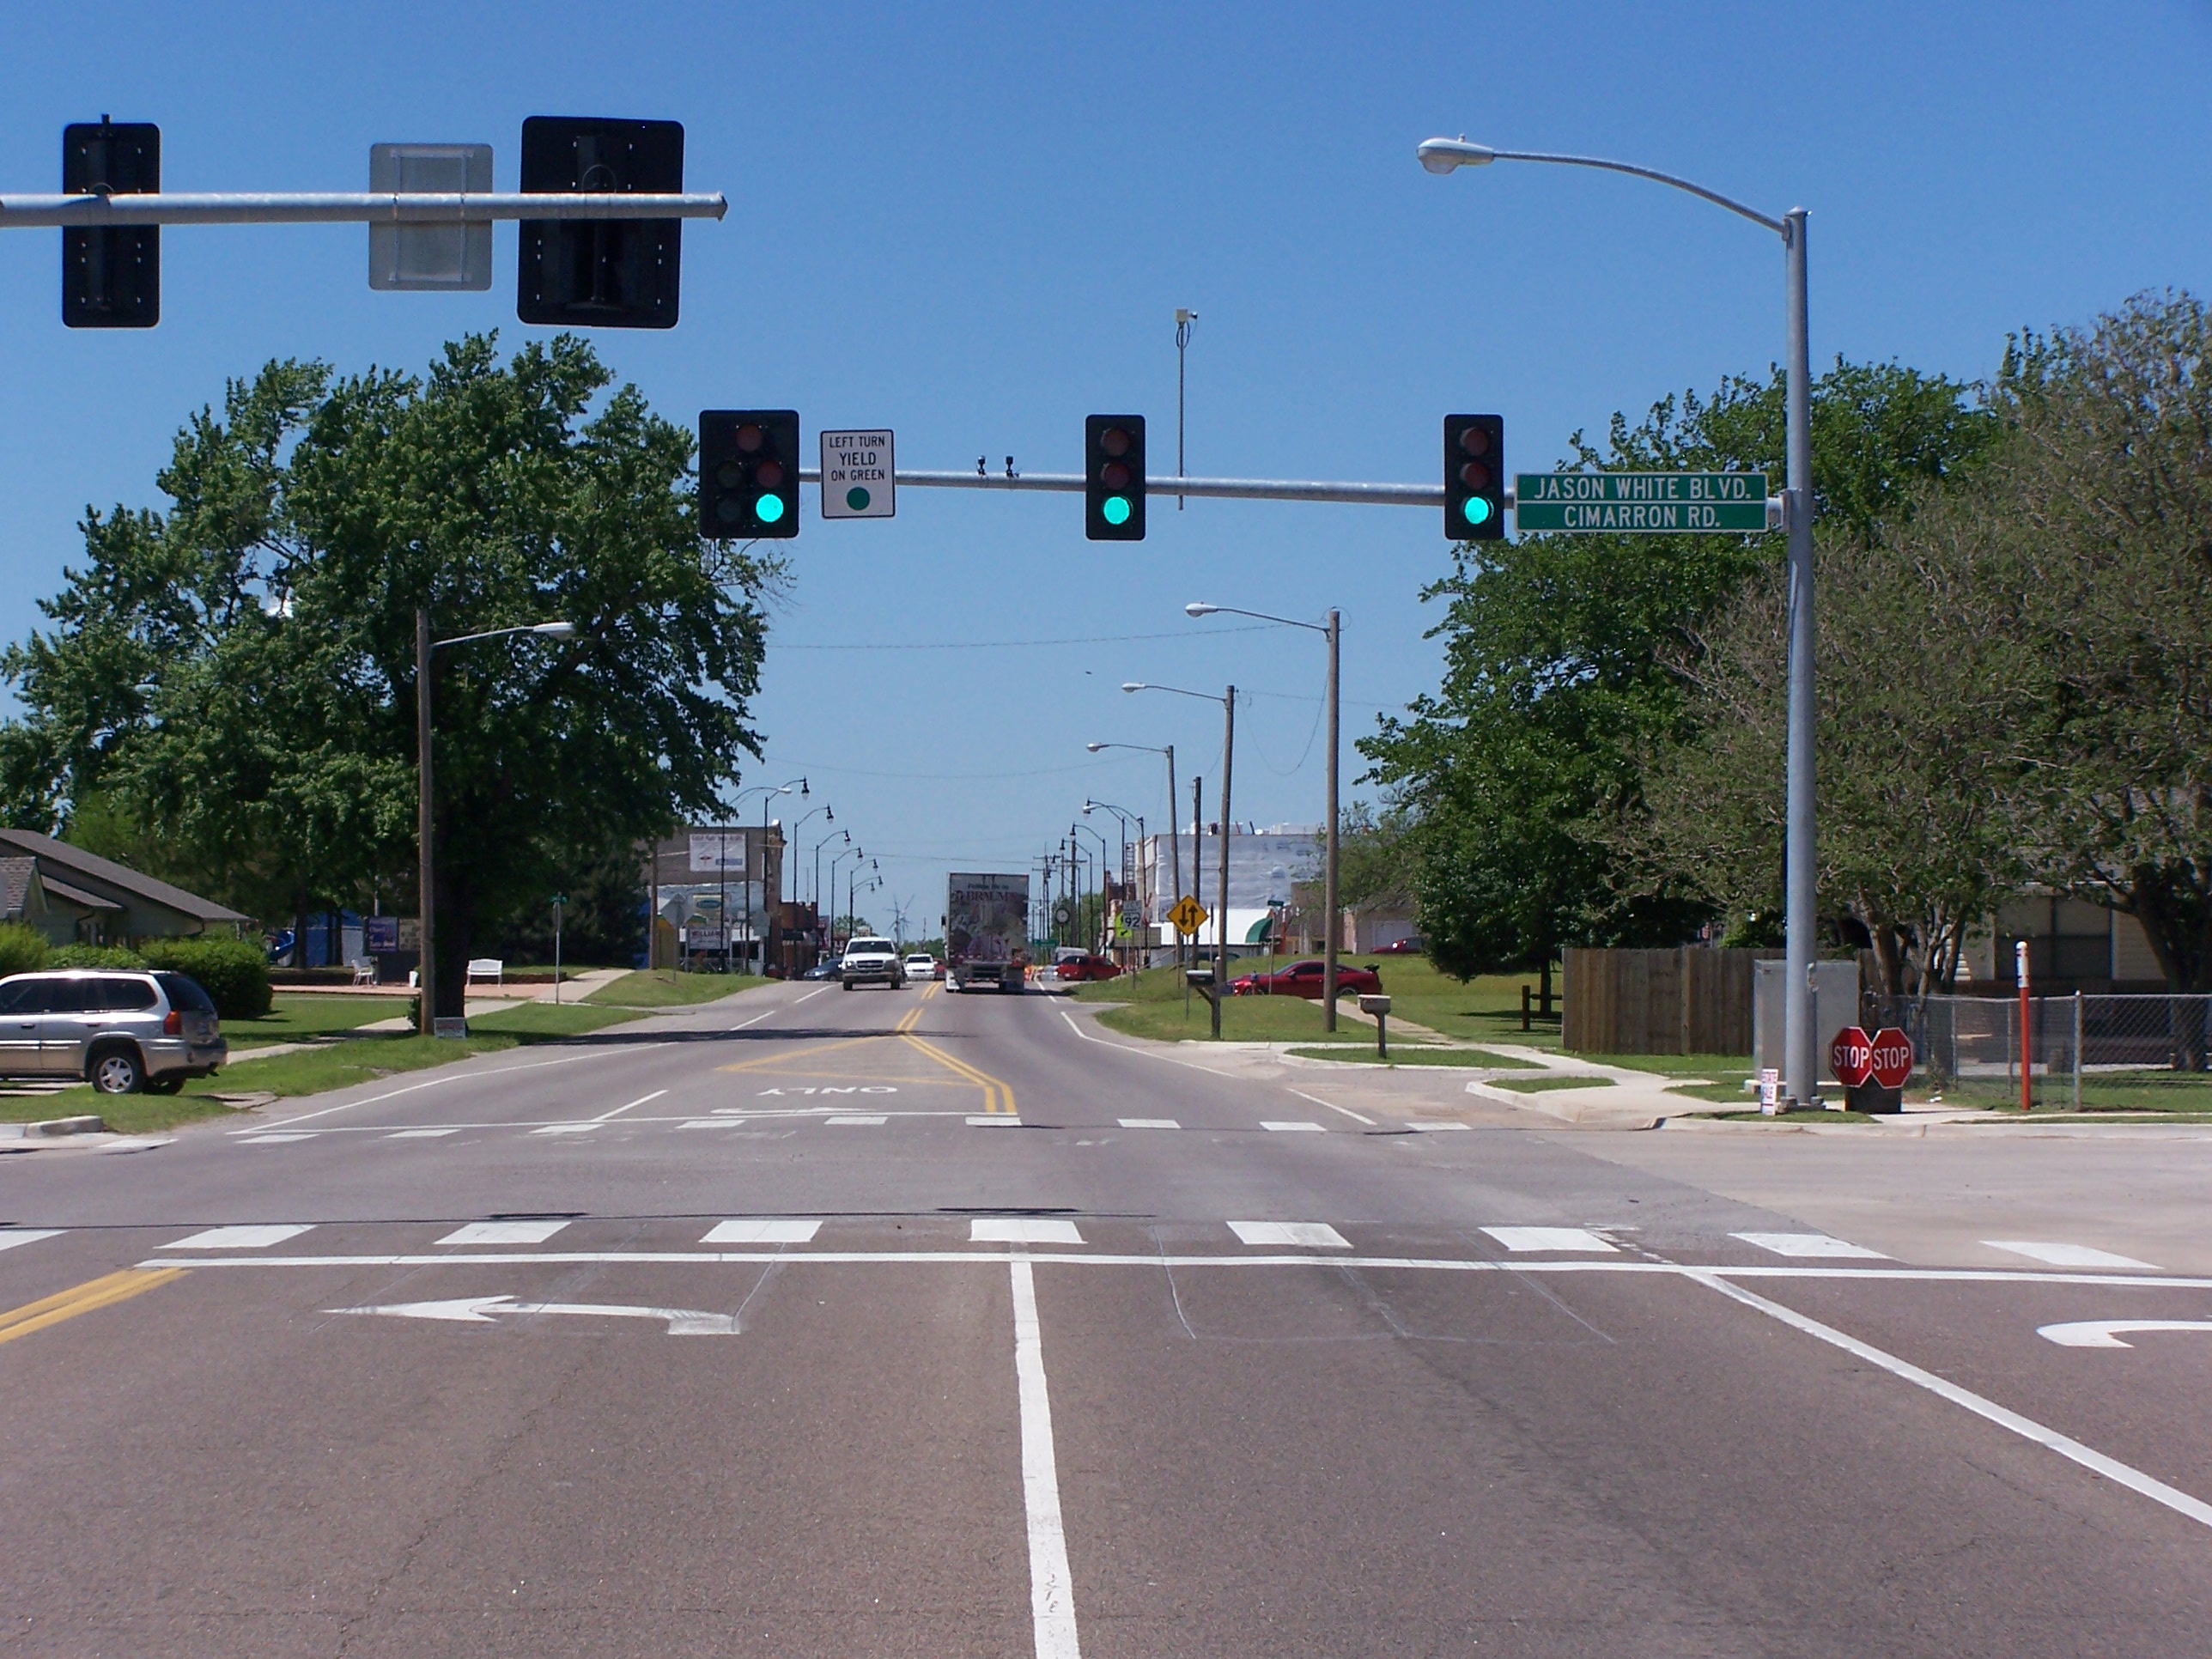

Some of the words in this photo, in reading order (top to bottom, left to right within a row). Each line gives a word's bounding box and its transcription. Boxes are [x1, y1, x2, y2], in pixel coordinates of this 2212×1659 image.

[830, 436, 854, 448] LEFT
[859, 435, 885, 447] TURN
[839, 452, 877, 466] YIELD
[830, 470, 846, 481] ON
[850, 469, 885, 481] GREEN
[1534, 477, 1606, 500] JASON
[1615, 477, 1680, 500] WHITE
[1689, 477, 1752, 500] BLVD.
[1564, 505, 1677, 528] CIMARRON
[1687, 505, 1722, 528] RD.
[1124, 916, 1140, 928] 92
[1833, 1044, 1869, 1068] STOP
[1873, 1046, 1910, 1071] STOP
[755, 1086, 898, 1096] ONLY
